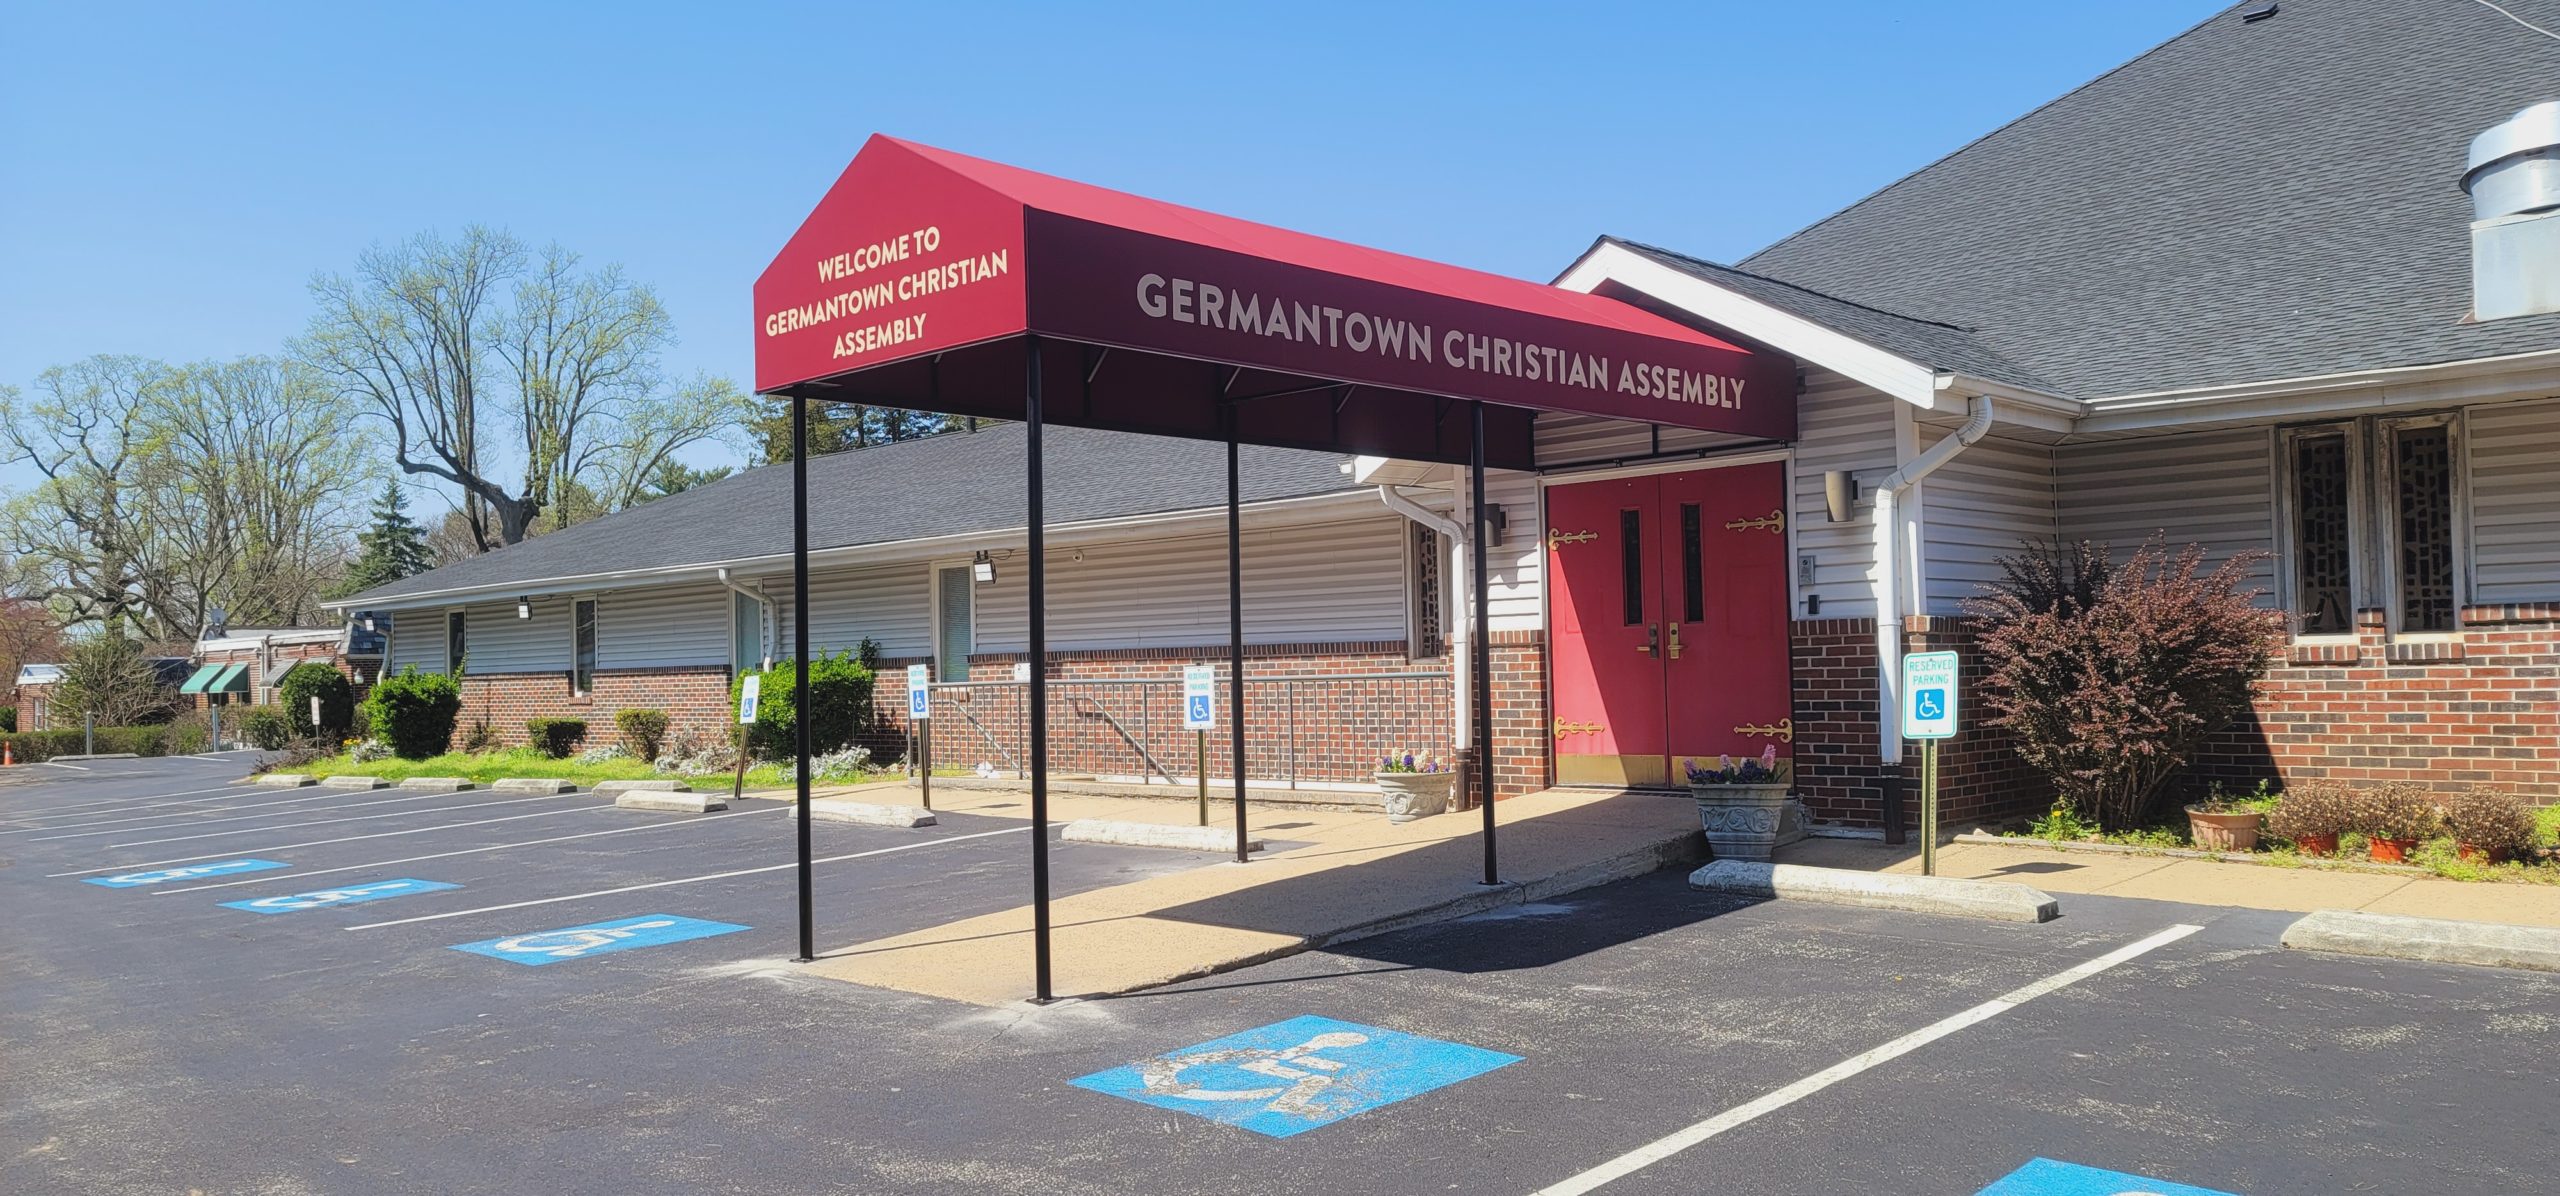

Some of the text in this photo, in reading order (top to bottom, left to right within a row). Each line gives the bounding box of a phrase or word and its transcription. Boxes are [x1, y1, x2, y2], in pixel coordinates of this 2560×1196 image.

[818, 226, 940, 283] WELCOME TO
[766, 249, 1008, 337] GERMANTOWN CHRISTIAN
[833, 313, 927, 359] ASSEMBLY
[1136, 272, 1746, 410] GERMANTOWN CHRISTIAN ASSEMBLY
[1909, 660, 1953, 671] RESERVED
[1913, 674, 1949, 685] PARKING
